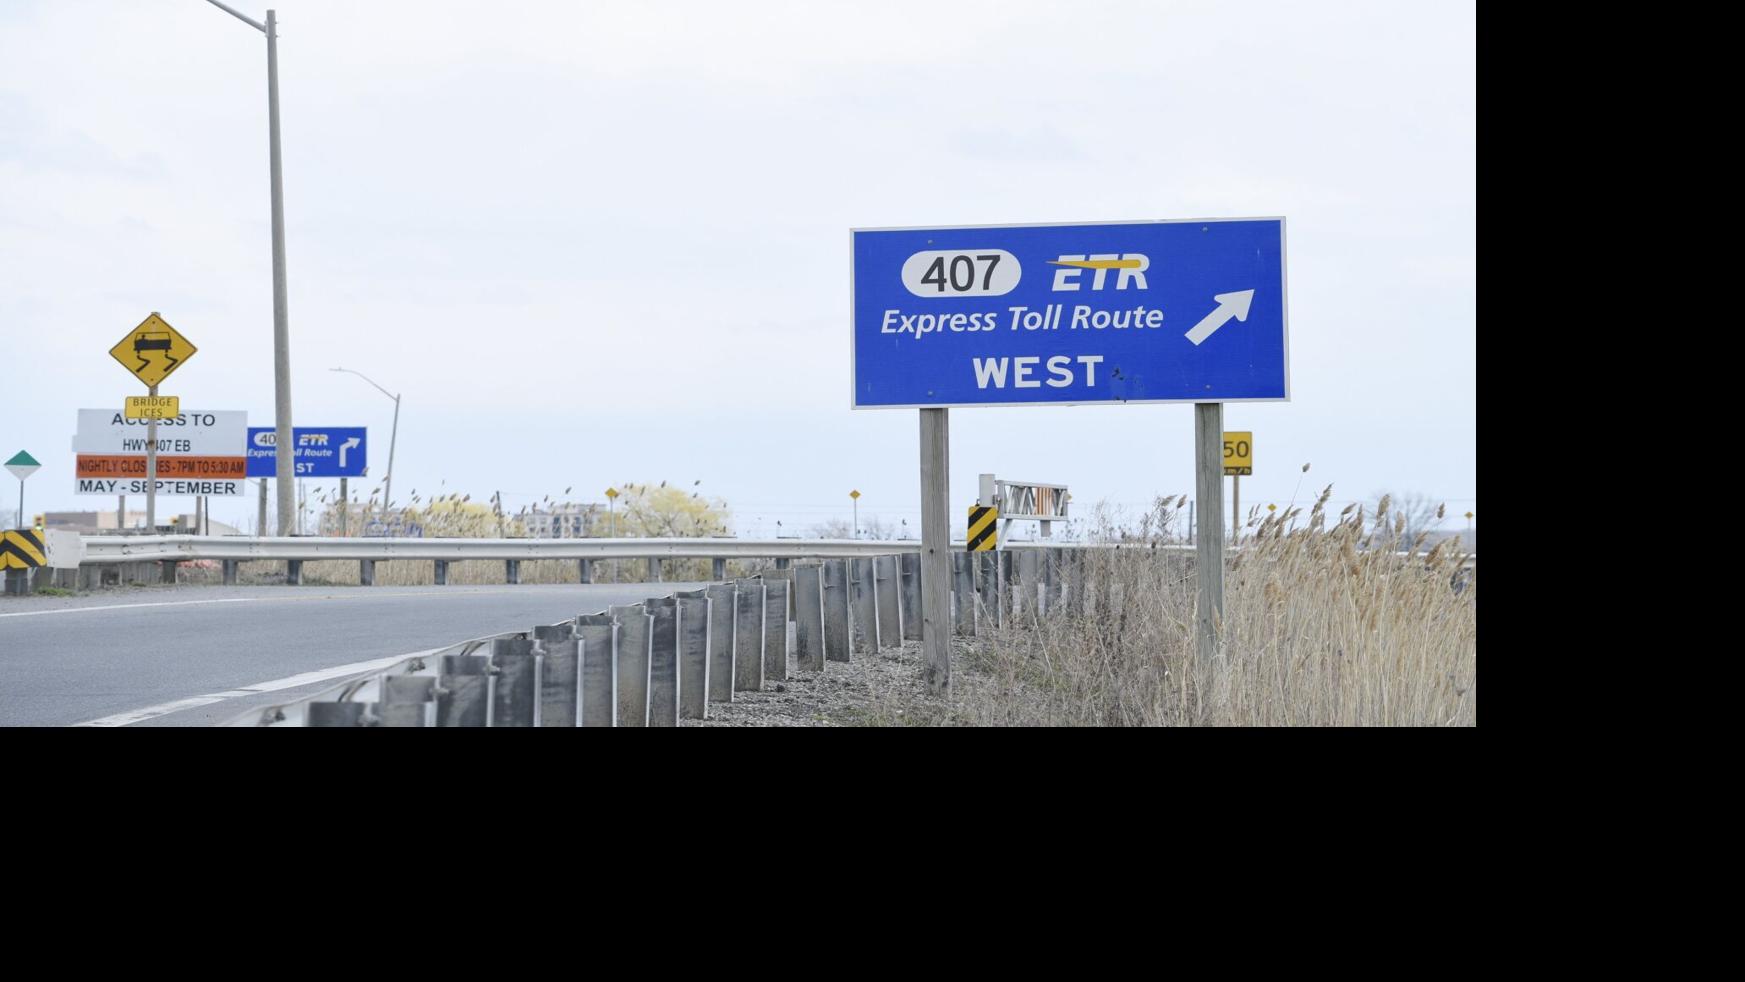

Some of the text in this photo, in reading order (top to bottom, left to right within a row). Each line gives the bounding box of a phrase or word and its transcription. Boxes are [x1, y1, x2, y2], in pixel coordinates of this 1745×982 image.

[920, 252, 1150, 292] 407 ETR
[881, 303, 1164, 340] Express Toll Route
[972, 355, 1104, 389] WEST
[132, 397, 172, 407] BRIDGE
[139, 408, 163, 417] ICES
[111, 413, 216, 427] ACCSS TO
[174, 440, 191, 452] EB
[259, 433, 329, 446] 40 ETR
[304, 448, 333, 457] Route
[1224, 441, 1249, 458] 50
[79, 460, 118, 473] NIGHTLY
[120, 460, 170, 474] CLOSES
[177, 461, 195, 473] 7PM
[197, 461, 209, 473] TO
[211, 461, 228, 473] 5:30
[230, 461, 244, 473] AM
[296, 462, 315, 473] ST
[79, 480, 118, 493] MAY
